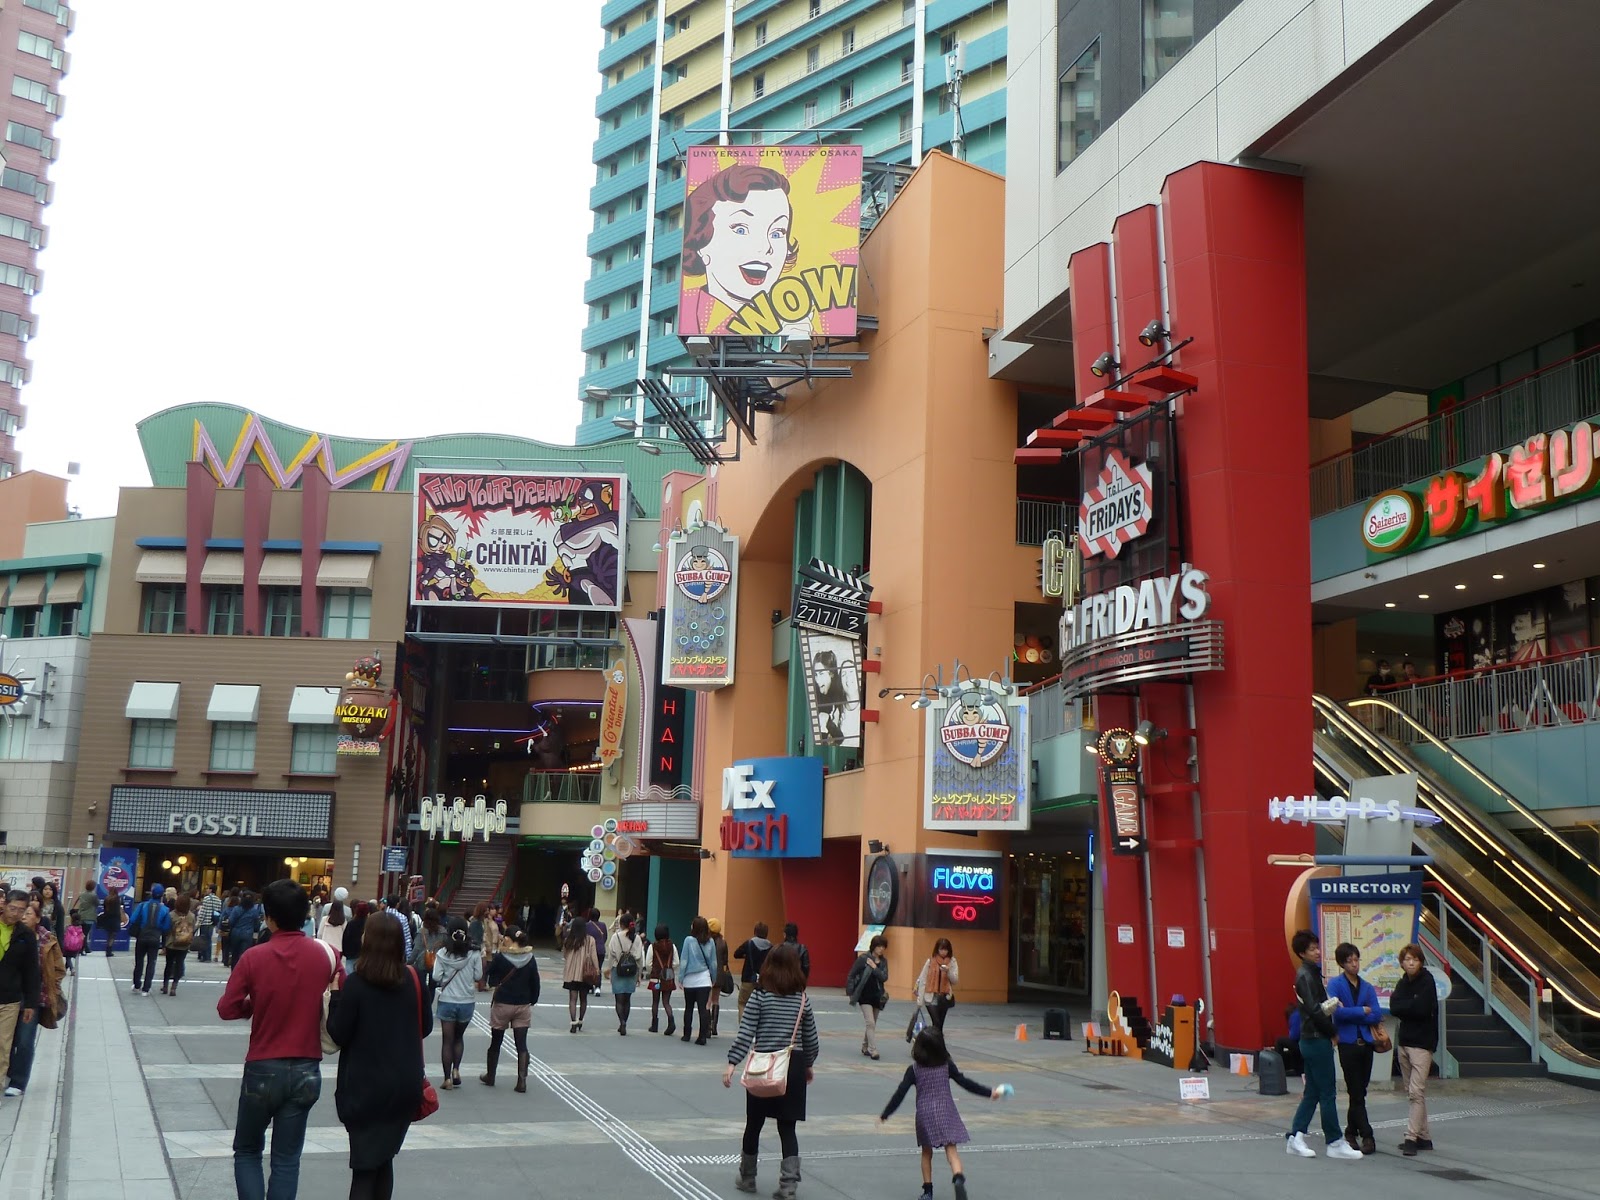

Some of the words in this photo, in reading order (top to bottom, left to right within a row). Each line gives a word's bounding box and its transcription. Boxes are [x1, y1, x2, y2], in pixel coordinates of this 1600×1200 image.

[693, 150, 754, 158] UNIVERSAL
[758, 150, 815, 158] CITYWALK
[820, 149, 858, 157] OSAKA
[1424, 421, 1600, 537] サイゼリ
[467, 477, 513, 507] YOUR
[490, 528, 533, 536] お部屋探しは
[676, 571, 704, 583] BUBBA
[705, 569, 729, 582] GUMP
[848, 616, 860, 631] 3
[1138, 649, 1155, 661] Bar
[615, 705, 624, 728] Diner
[943, 726, 976, 742] BUBBA
[978, 725, 1008, 740] GUMP
[602, 749, 616, 758] 4F
[1113, 788, 1138, 834] GAME
[1285, 795, 1401, 821] SHOPS
[168, 813, 264, 836] FOSSIL
[953, 866, 973, 874] HEAD
[973, 866, 993, 874] WEAR
[933, 867, 993, 890] Flava
[1321, 882, 1411, 894] DIRECTORY
[952, 905, 977, 921] GO
